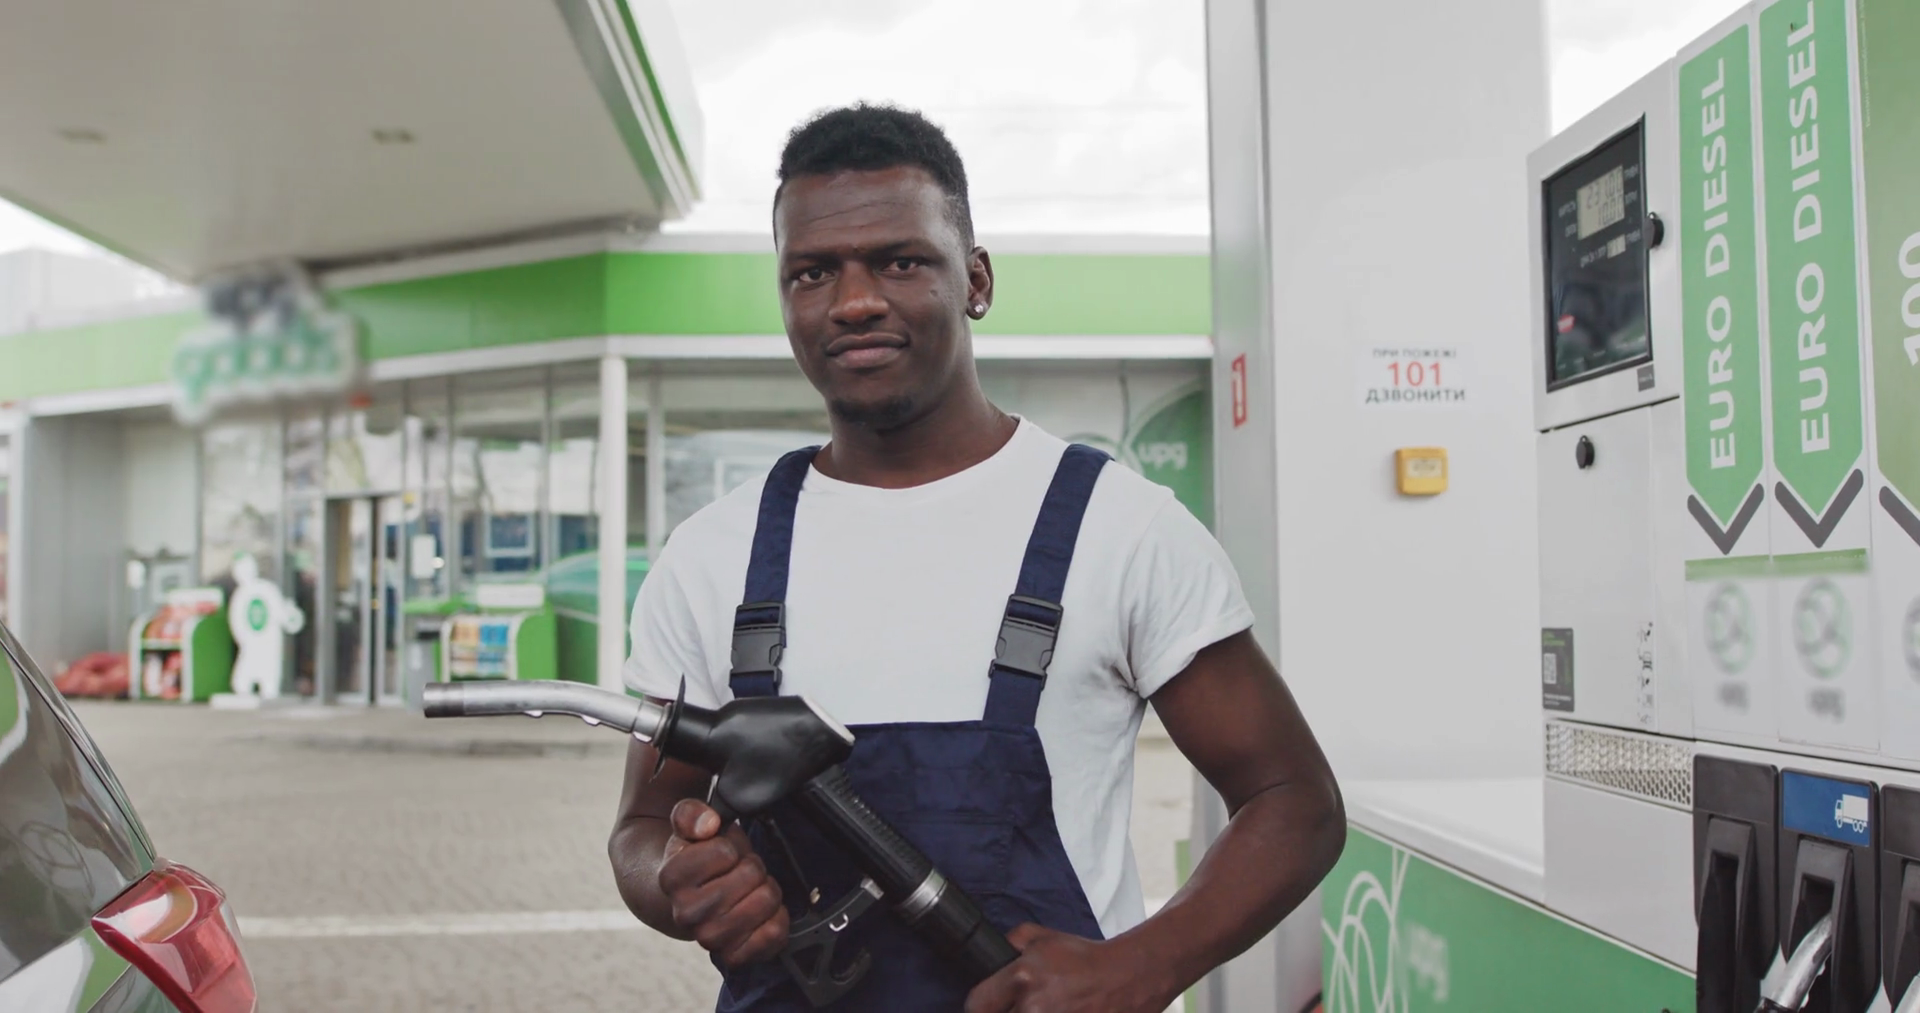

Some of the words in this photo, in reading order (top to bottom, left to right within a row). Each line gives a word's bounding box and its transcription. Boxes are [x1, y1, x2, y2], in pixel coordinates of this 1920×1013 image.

[1701, 57, 1730, 278] DIESEL
[1787, 0, 1823, 243] DIESEL
[1373, 349, 1398, 358] ПРИ
[1387, 361, 1442, 387] 101
[1796, 262, 1831, 454] EURO
[1899, 231, 1920, 366] 100
[1366, 389, 1465, 403] ДЗВОНИТИ
[1706, 295, 1736, 469] EURO
